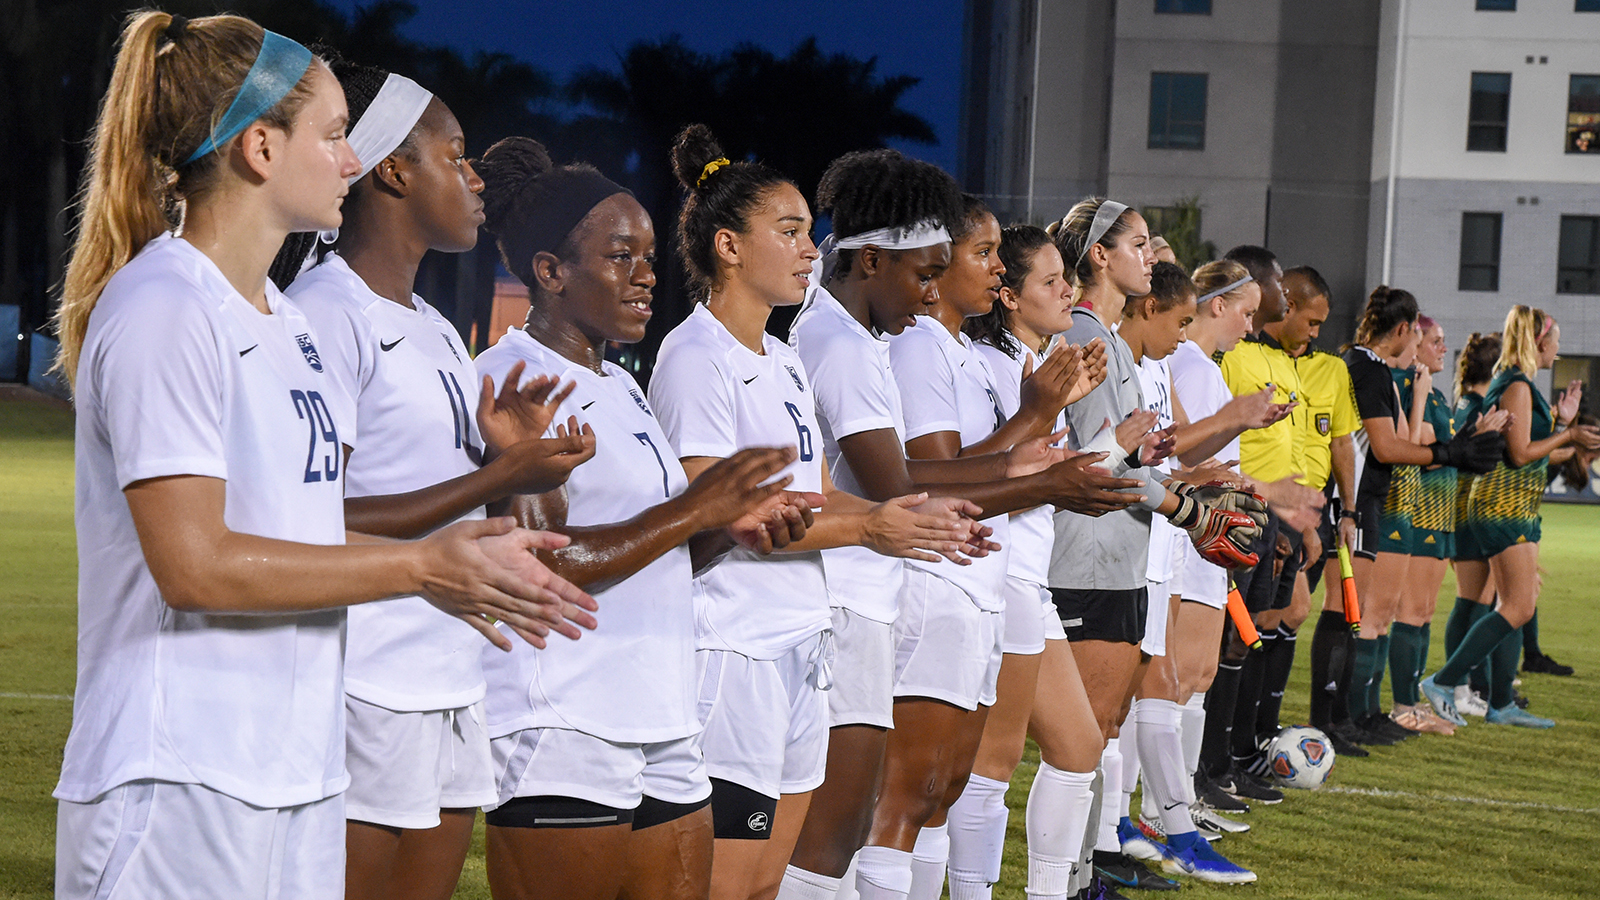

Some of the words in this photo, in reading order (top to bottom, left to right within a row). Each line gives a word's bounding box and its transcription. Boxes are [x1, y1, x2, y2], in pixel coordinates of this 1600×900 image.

[290, 390, 339, 483] 29
[437, 369, 470, 450] 11
[784, 401, 814, 462] 6
[633, 432, 670, 498] 7
